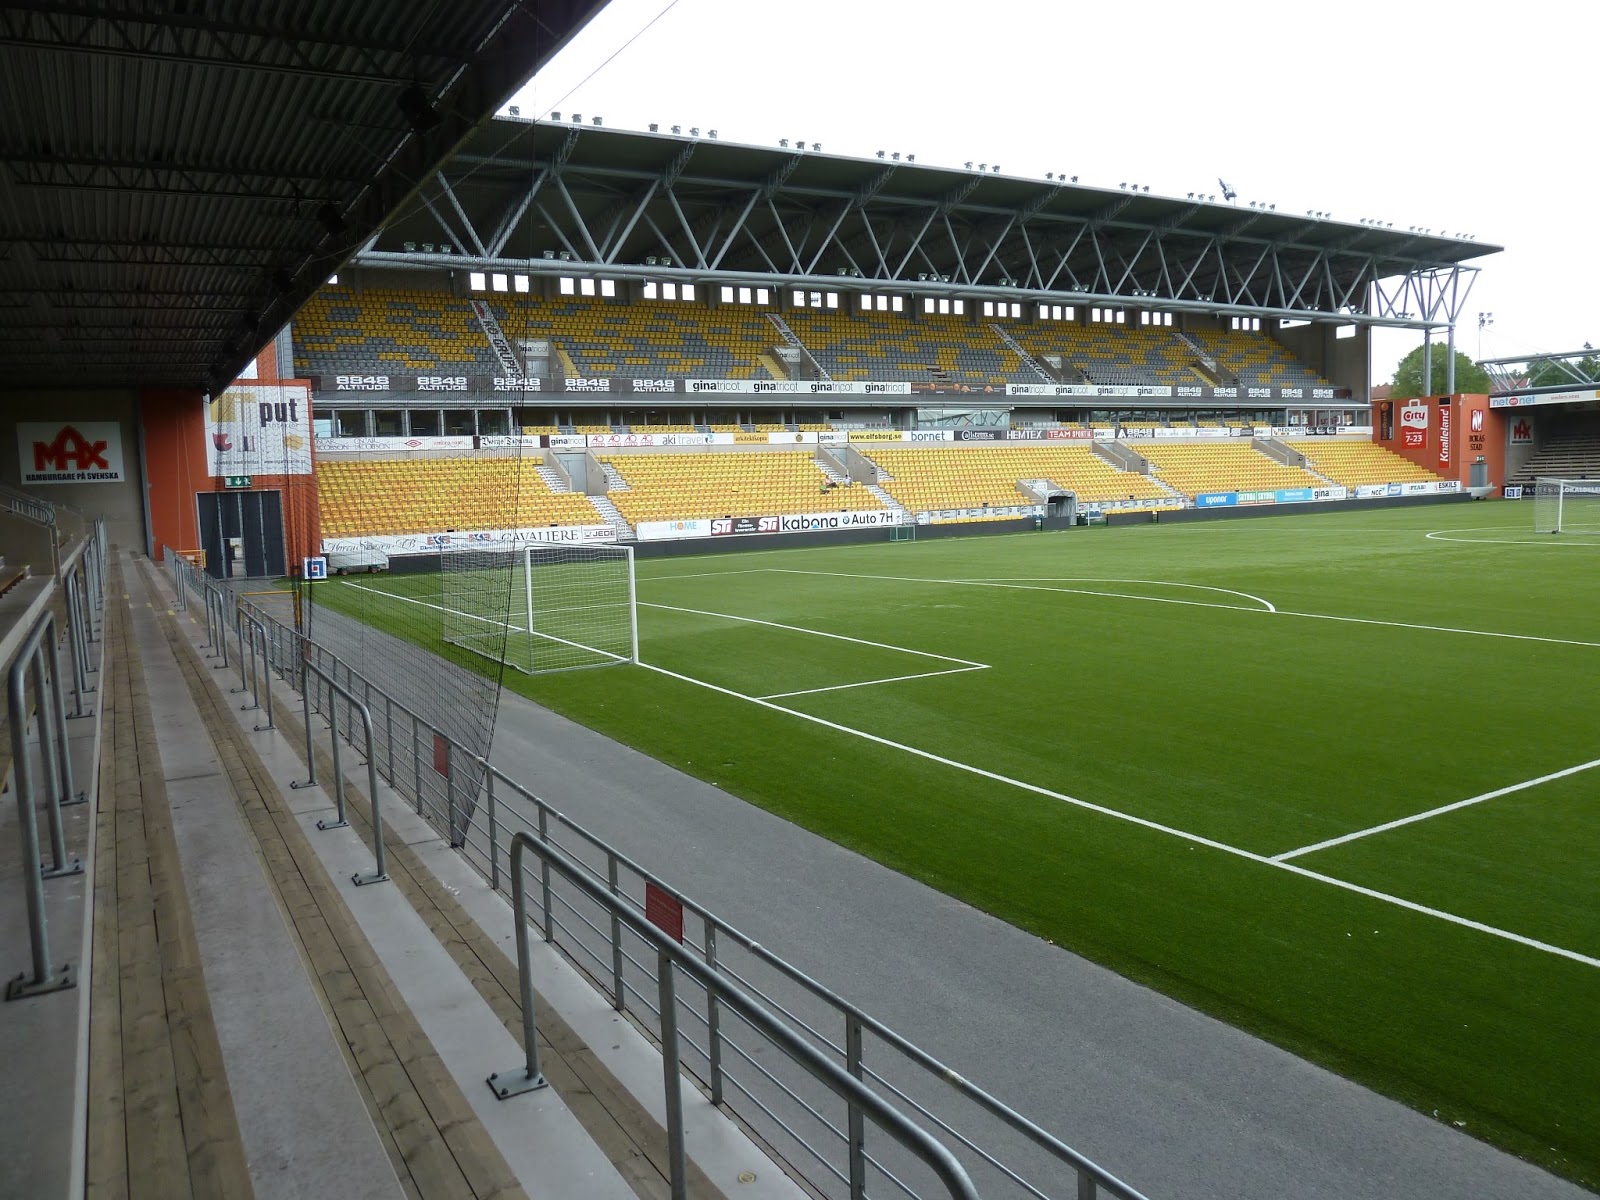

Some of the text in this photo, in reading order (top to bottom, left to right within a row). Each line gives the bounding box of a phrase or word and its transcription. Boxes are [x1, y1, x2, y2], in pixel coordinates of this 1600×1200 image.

[336, 376, 390, 384] 8848
[417, 377, 468, 385] 8848
[494, 378, 541, 386] 8848
[565, 378, 610, 386] 8848
[632, 379, 675, 387] 8848
[850, 431, 902, 441] www.elfsborg.se
[911, 431, 945, 441] bornet
[1006, 430, 1042, 440] HEMTEX
[1049, 430, 1071, 438] TEAM
[1405, 435, 1423, 443] 7-23
[1440, 409, 1449, 462] Knalleland
[662, 434, 676, 445] aki
[33, 425, 109, 471] MAX
[26, 472, 119, 481] HAMBURGARE PÅ SVENSKA
[1205, 495, 1227, 505] uponor
[782, 515, 838, 530] kabona
[852, 513, 893, 525] Auto 7H
[670, 521, 697, 531] HOME
